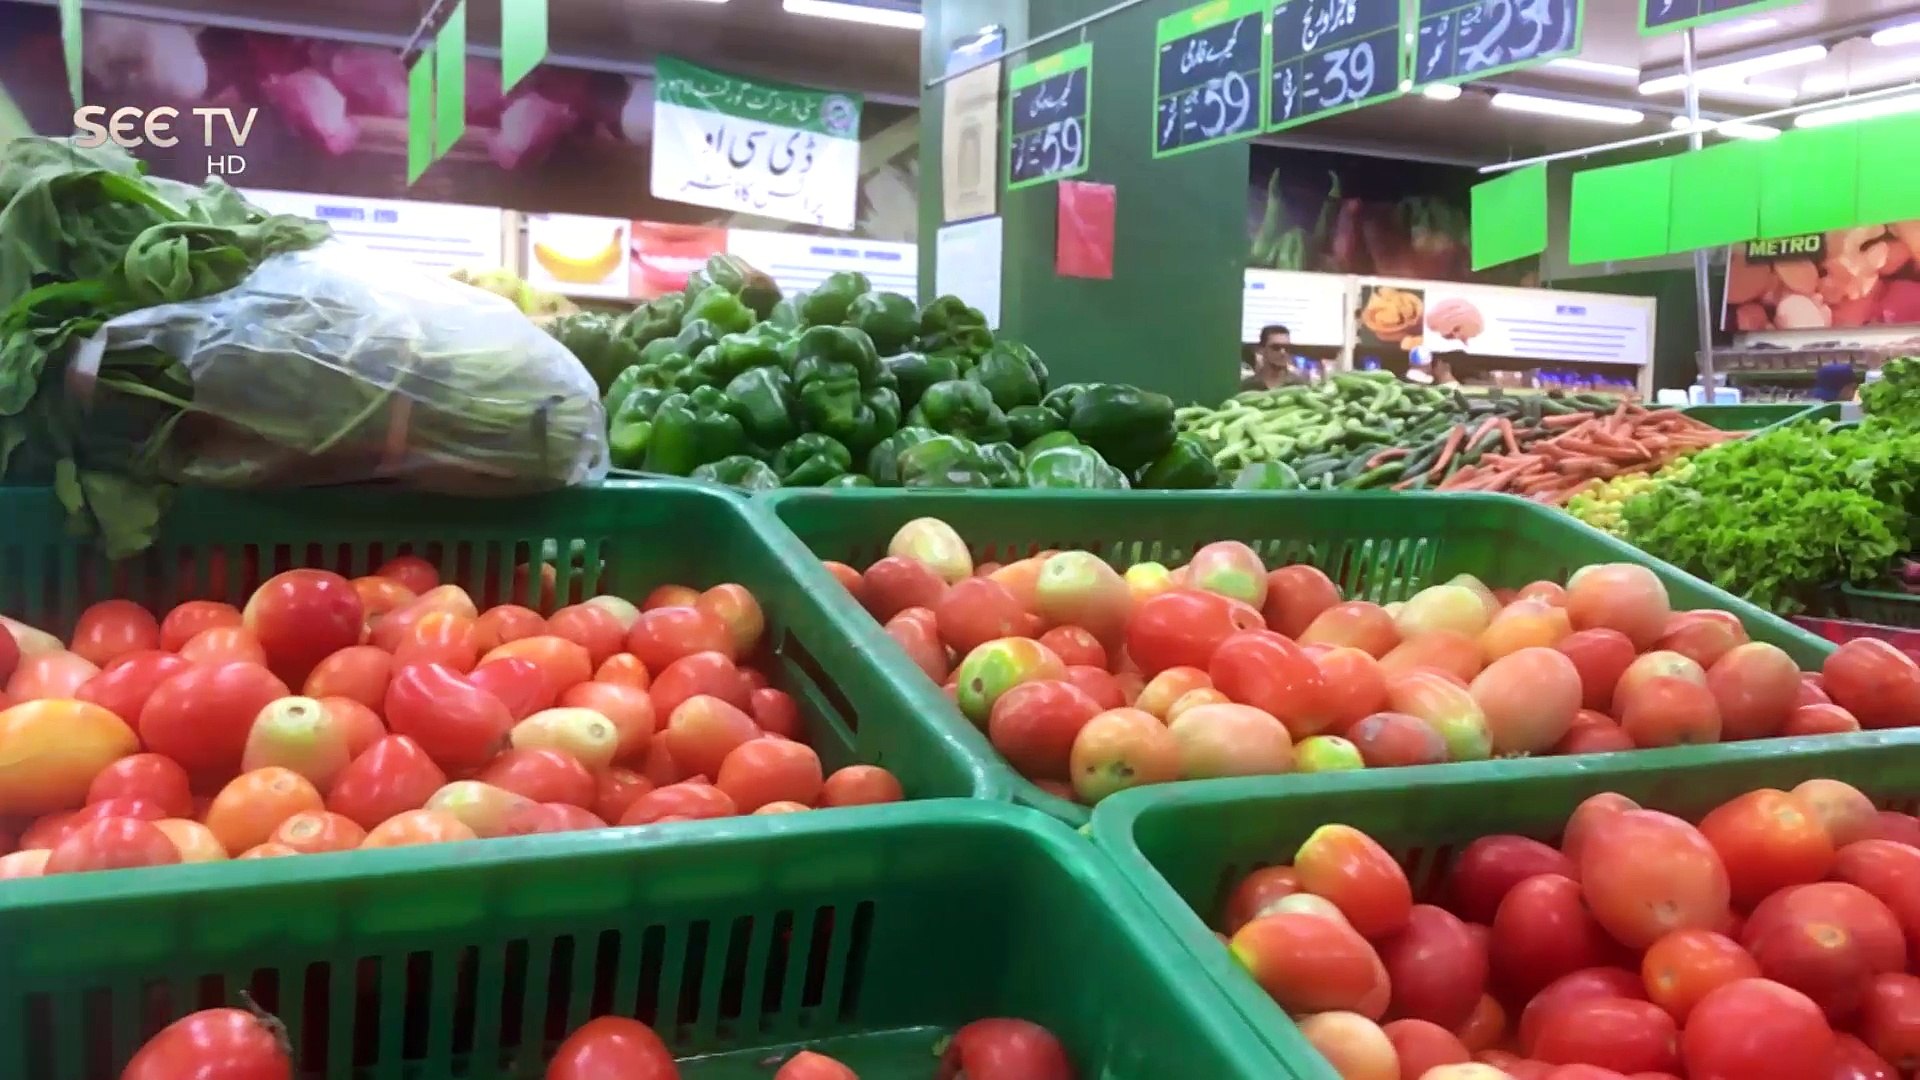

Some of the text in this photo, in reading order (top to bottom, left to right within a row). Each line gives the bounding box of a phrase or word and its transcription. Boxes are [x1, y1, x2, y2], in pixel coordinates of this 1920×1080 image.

[1200, 70, 1250, 137] 59
[1319, 41, 1376, 107] 39
[1041, 117, 1083, 176] 59
[1748, 234, 1821, 257] METRO
